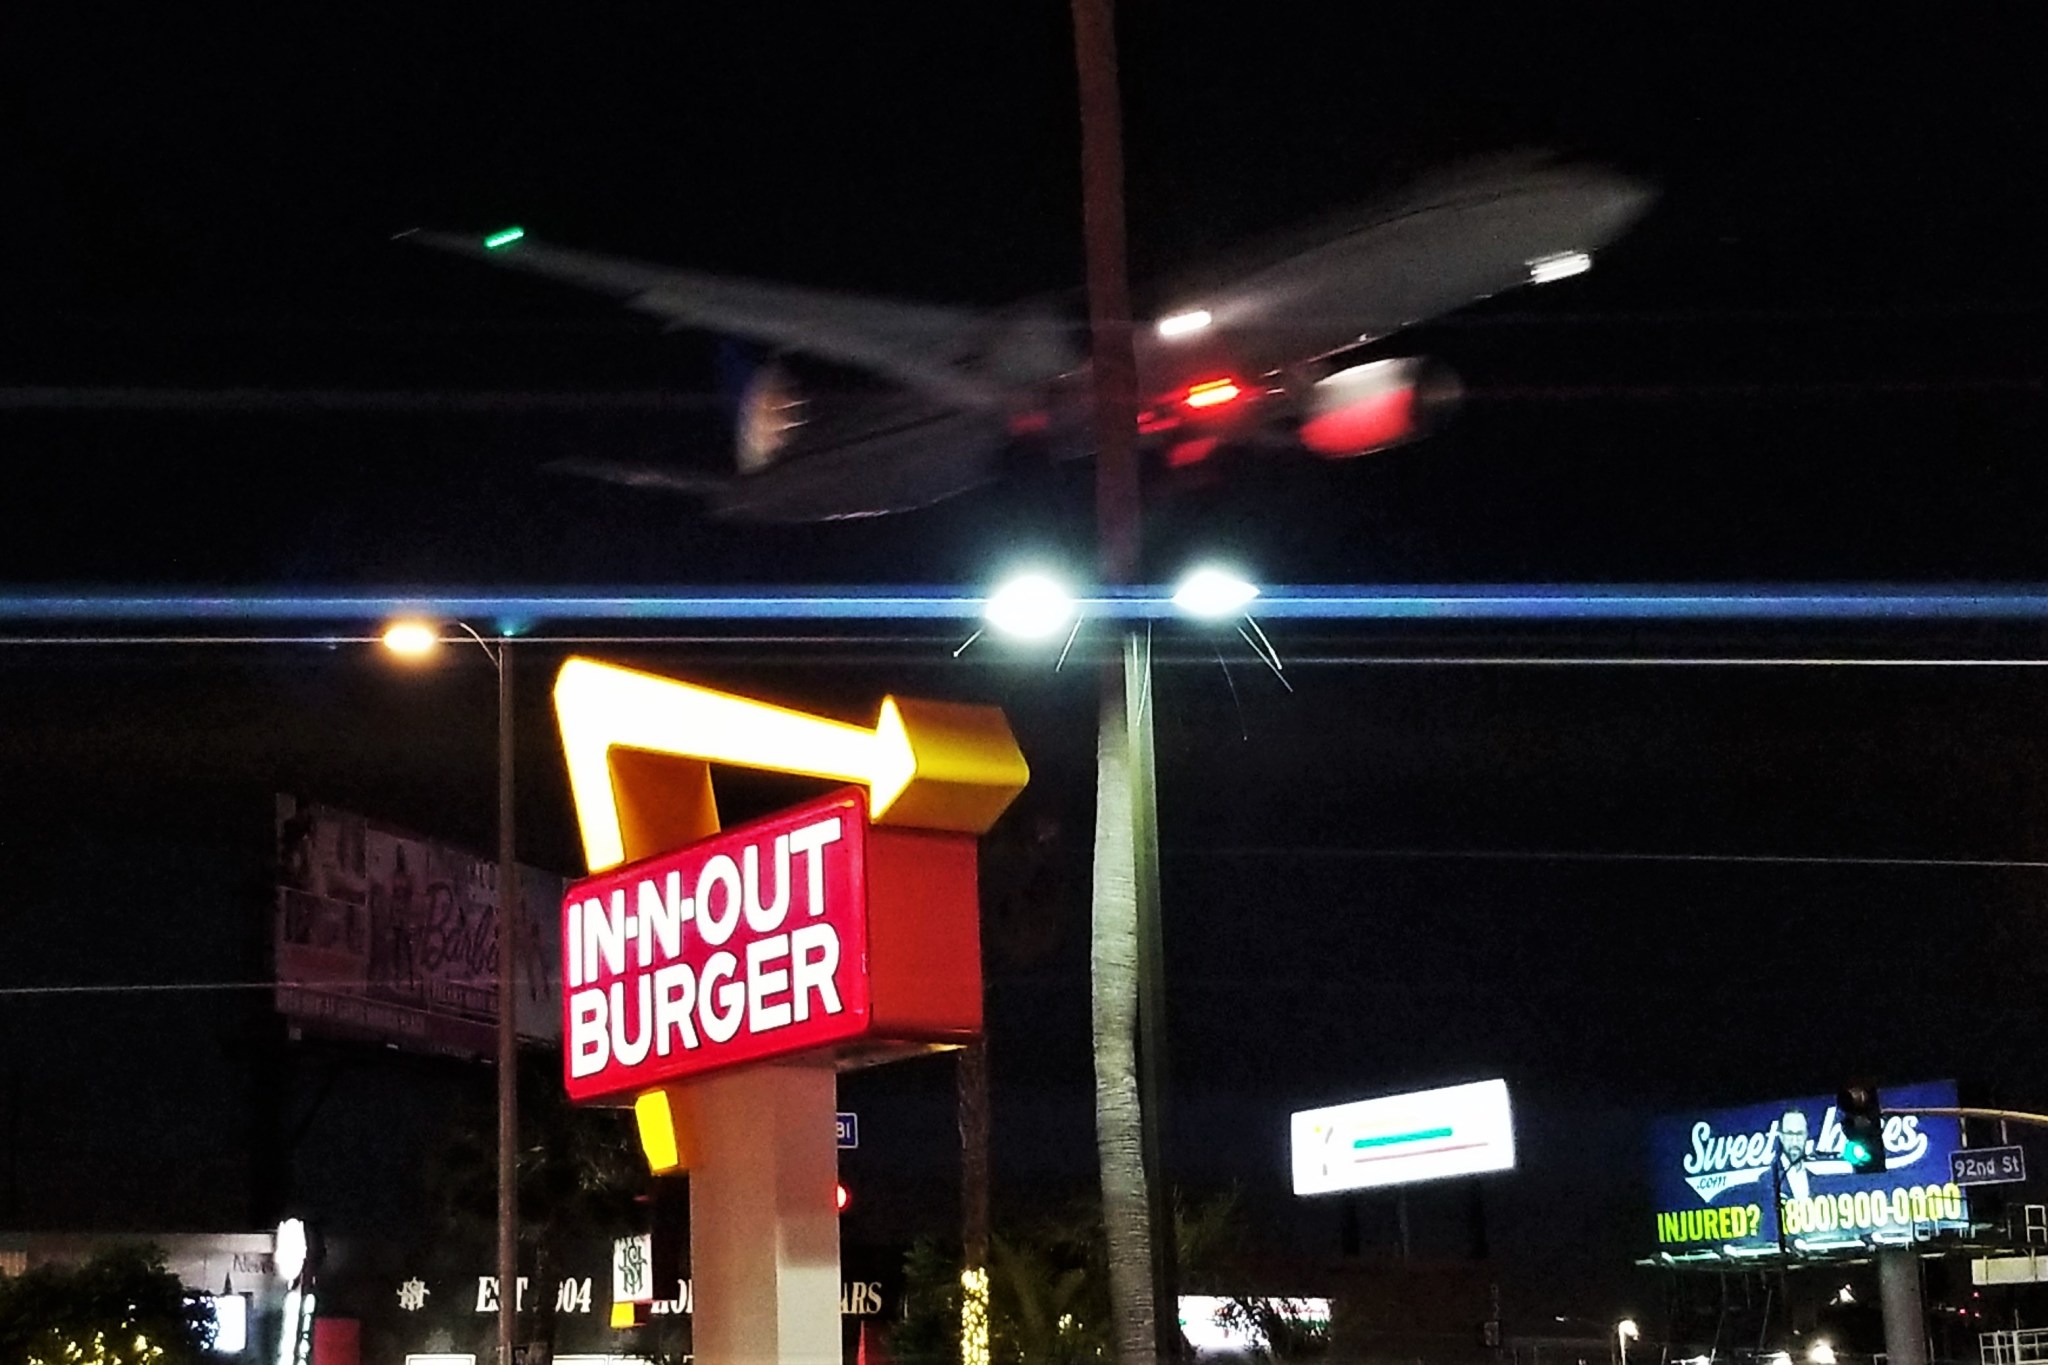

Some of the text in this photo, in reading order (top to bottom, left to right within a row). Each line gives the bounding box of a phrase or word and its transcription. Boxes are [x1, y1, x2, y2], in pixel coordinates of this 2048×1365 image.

[569, 816, 843, 988] IN-N-OUT
[570, 922, 843, 1078] BURGER
[1683, 1119, 1780, 1174] Sweet
[1954, 1155, 2020, 1178] 92nd St
[1657, 1204, 1761, 1243] INJURED?
